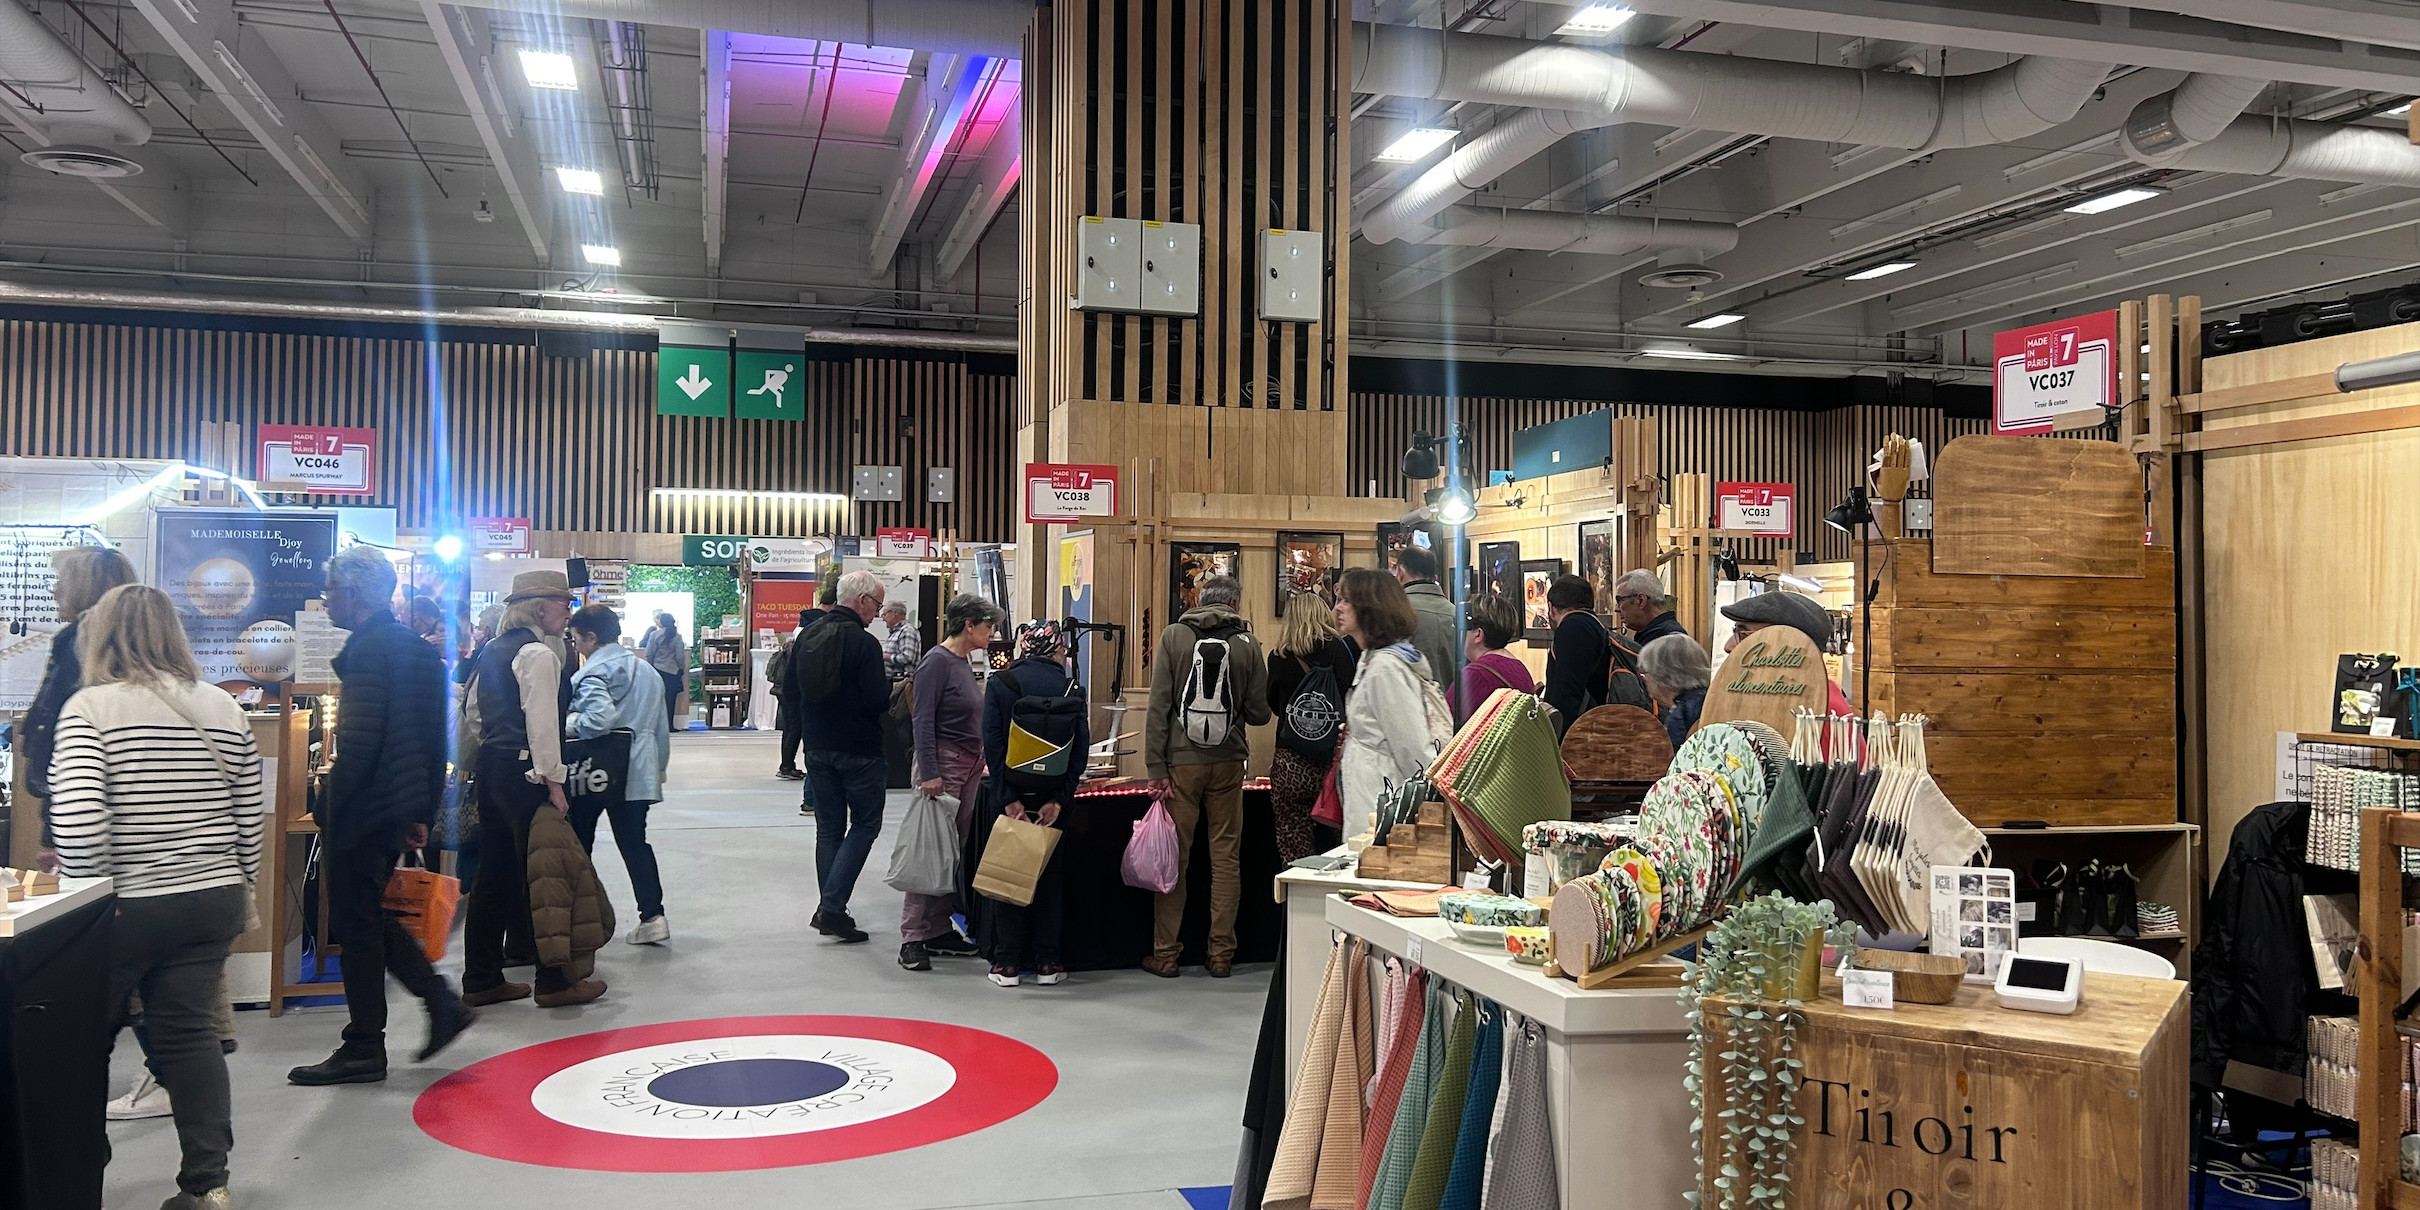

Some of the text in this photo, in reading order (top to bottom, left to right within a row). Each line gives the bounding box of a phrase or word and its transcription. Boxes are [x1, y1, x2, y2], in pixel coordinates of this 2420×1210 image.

[2027, 337, 2048, 347] MADE
[2060, 333, 2074, 360] 7
[2027, 349, 2035, 358] IN
[2029, 370, 2075, 391] VC037
[326, 436, 339, 452] 7
[295, 457, 340, 469] VC046
[1079, 473, 1089, 487] 7
[1055, 491, 1090, 501] VC038
[1761, 490, 1770, 503] 7
[1741, 508, 1770, 516] VC033
[505, 522, 512, 531] 7
[191, 529, 281, 540] MADEMOISELLE
[907, 532, 914, 540] 7
[279, 537, 302, 549] Djoy
[426, 563, 464, 574] FLEUR
[187, 580, 211, 588] bijoux
[1741, 642, 1806, 668] Charlottes
[221, 663, 289, 676] précieuses
[2283, 770, 2294, 780] Le
[821, 1050, 894, 1092] VILLAGE
[601, 1049, 732, 1108] FRANÇAISE
